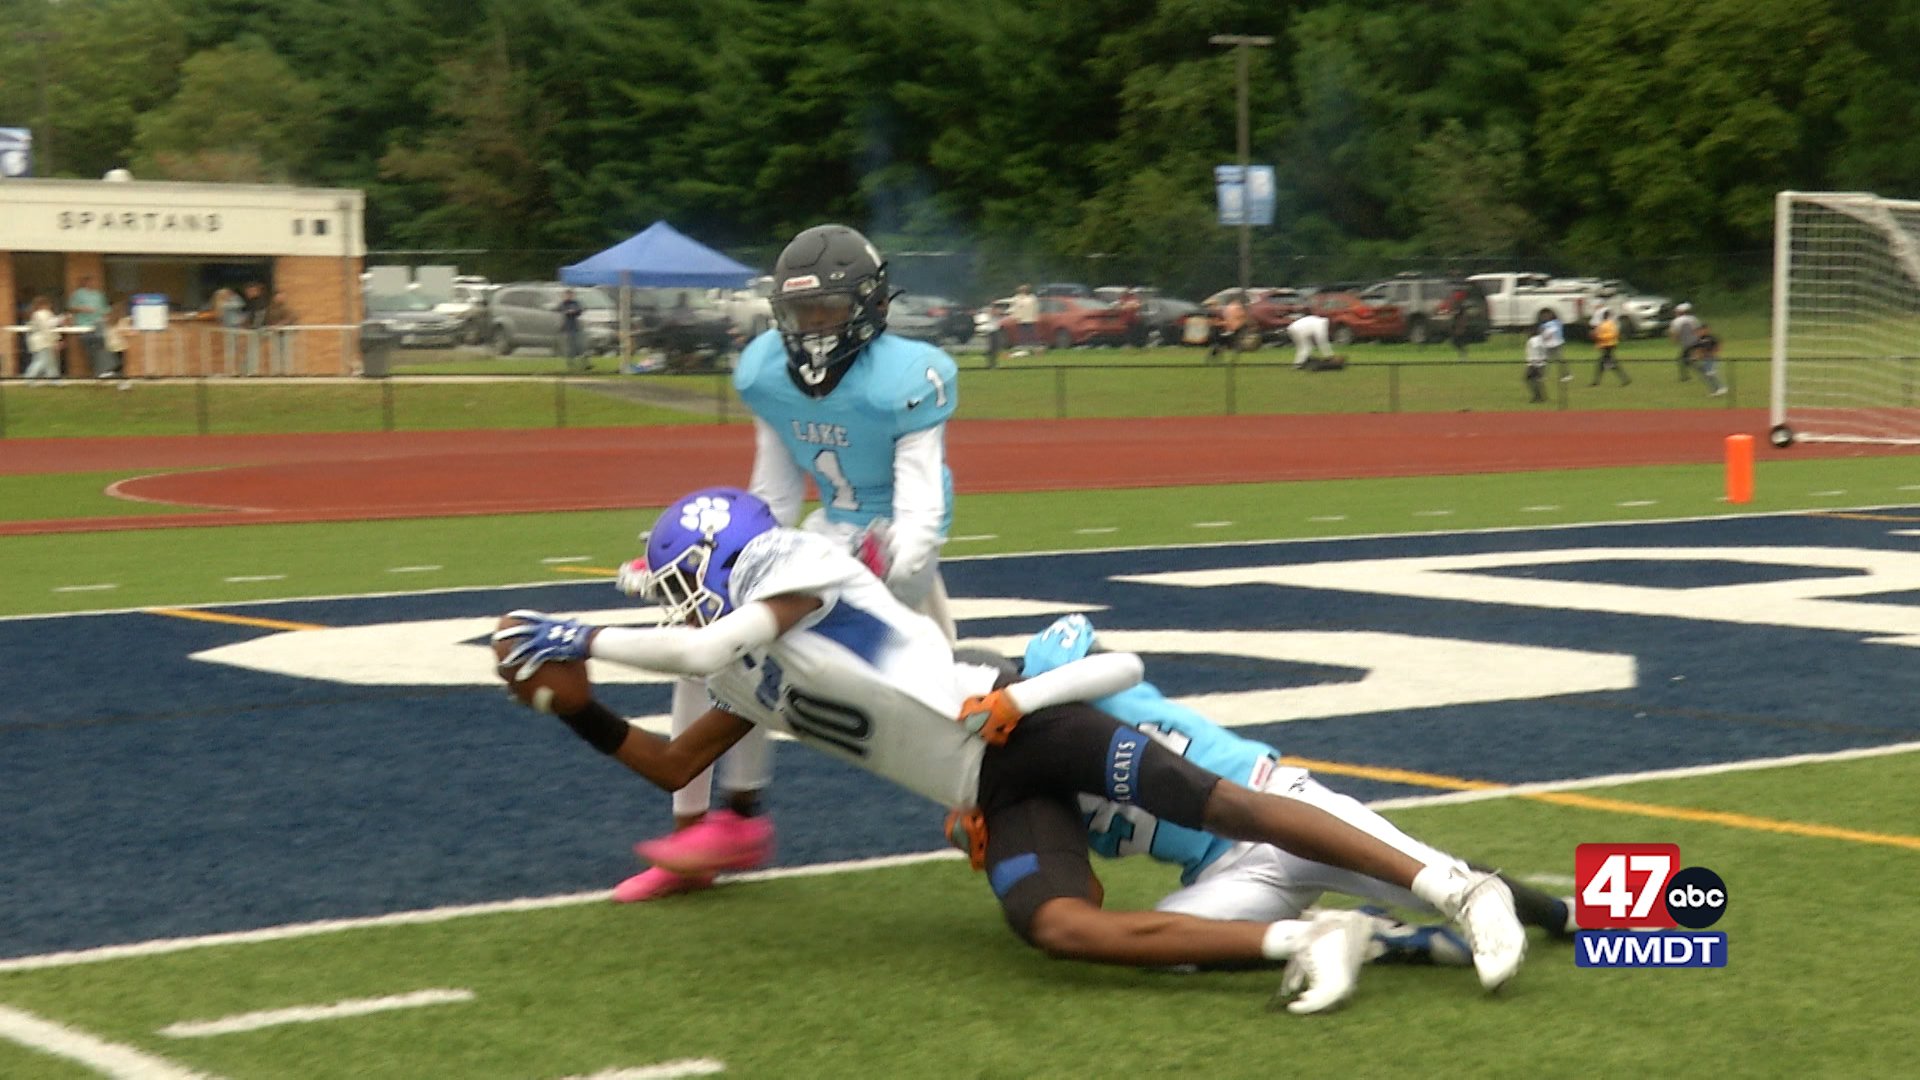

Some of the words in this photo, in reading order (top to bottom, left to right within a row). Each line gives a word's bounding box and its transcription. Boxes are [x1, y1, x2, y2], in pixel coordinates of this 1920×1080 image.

[57, 210, 223, 232] SPARTANS
[925, 367, 947, 407] 1
[792, 420, 850, 447] LAKE
[814, 449, 860, 511] 1
[785, 686, 872, 757] 10
